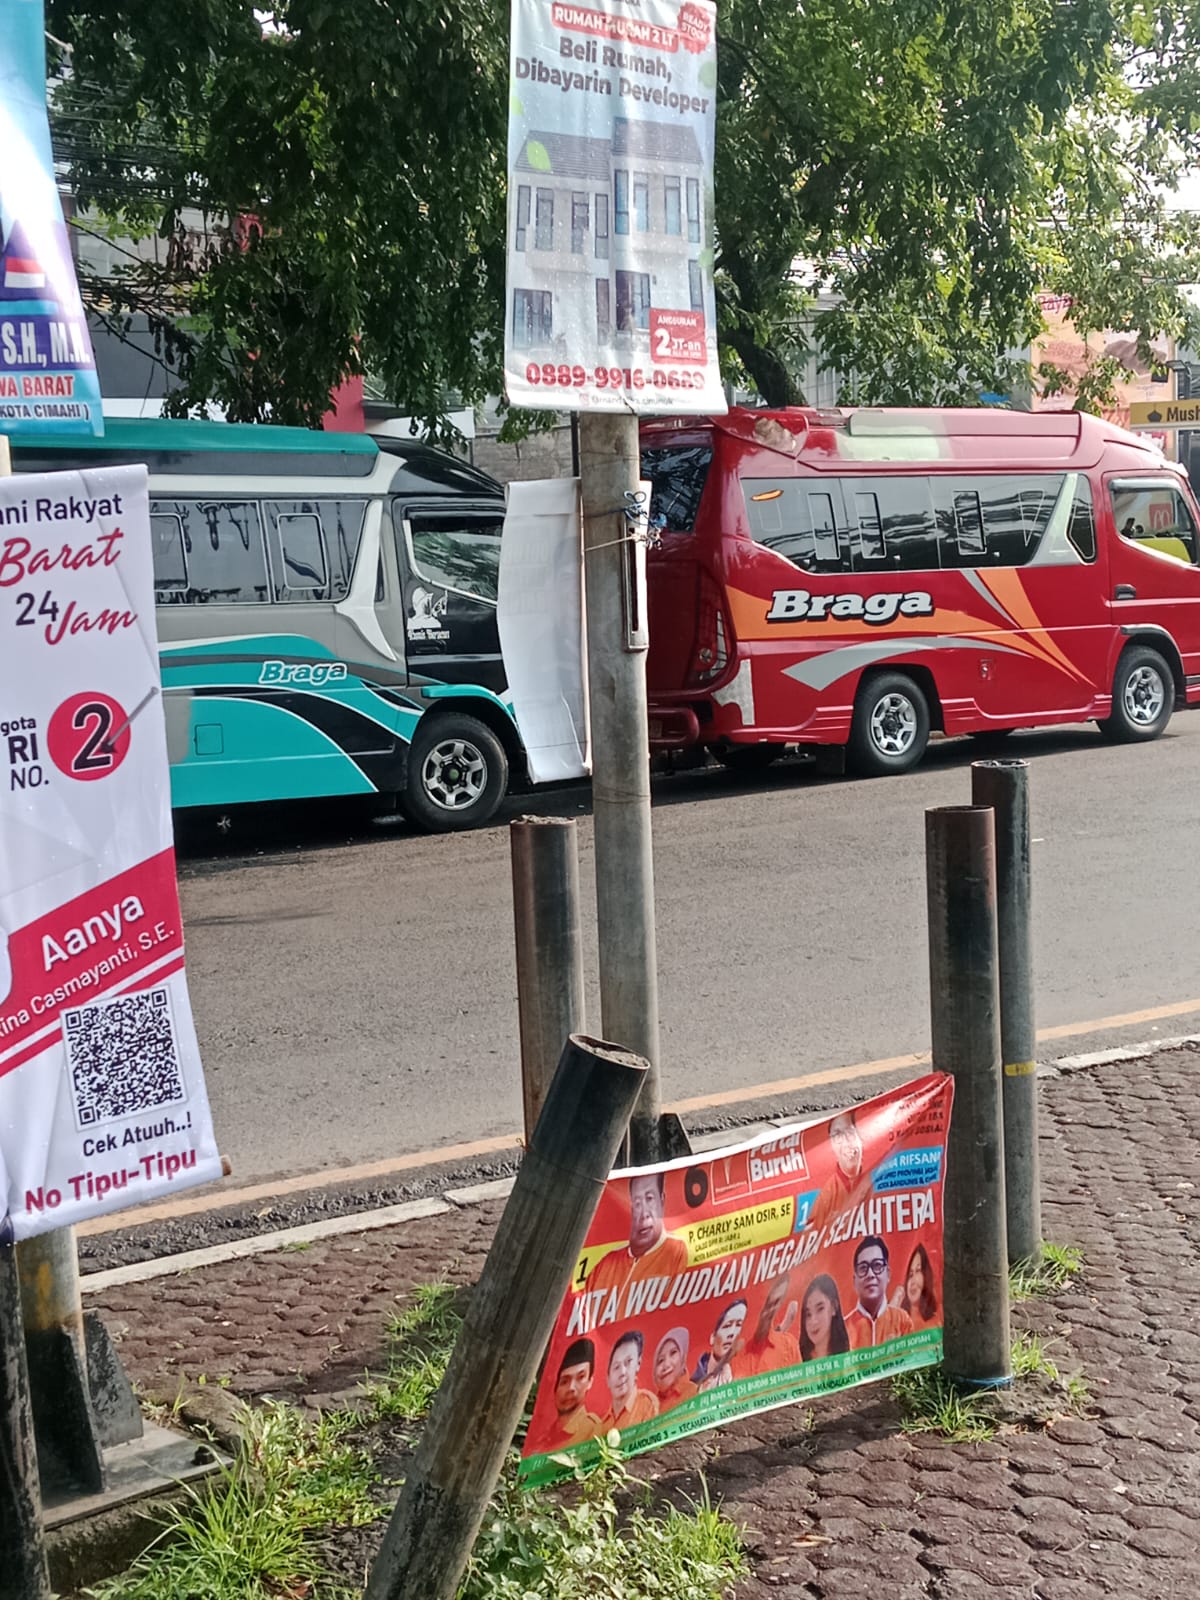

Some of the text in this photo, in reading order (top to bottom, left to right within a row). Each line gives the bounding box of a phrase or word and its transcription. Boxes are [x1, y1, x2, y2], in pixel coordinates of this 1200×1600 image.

[554, 7, 600, 30] RUMAH
[651, 29, 661, 44] 2
[661, 33, 675, 47] LT
[559, 36, 673, 83] Beli Rumah,
[515, 57, 710, 114] Dibayarin Developer
[1, 321, 48, 368] S.H.,
[654, 328, 672, 357] 2
[23, 375, 74, 397] BARAT
[34, 404, 81, 418] CIMAHI
[36, 493, 123, 523] Rakyat
[0, 527, 124, 587] Barat
[16, 590, 138, 645] 24 Jam
[767, 588, 936, 624] Braga
[258, 660, 348, 684] Braga
[8, 733, 39, 764] RI
[71, 700, 114, 773] 2
[11, 765, 50, 791] NO.
[41, 894, 145, 972] Aanya
[30, 942, 139, 1015] Casmayanti,
[138, 920, 176, 951] S.E.
[82, 1111, 193, 1157] Cek Atuuh..!
[24, 1149, 197, 1215] No Tipu-Tipu
[750, 1148, 807, 1183] Buruh
[696, 1219, 733, 1241] CHARLY
[733, 1213, 755, 1231] SAM
[780, 1203, 792, 1217] SE
[797, 1200, 811, 1226] 1
[566, 1188, 936, 1337] KITA WUJUDKAN NEGARA SEJAHTERA
[575, 1256, 589, 1284] 1
